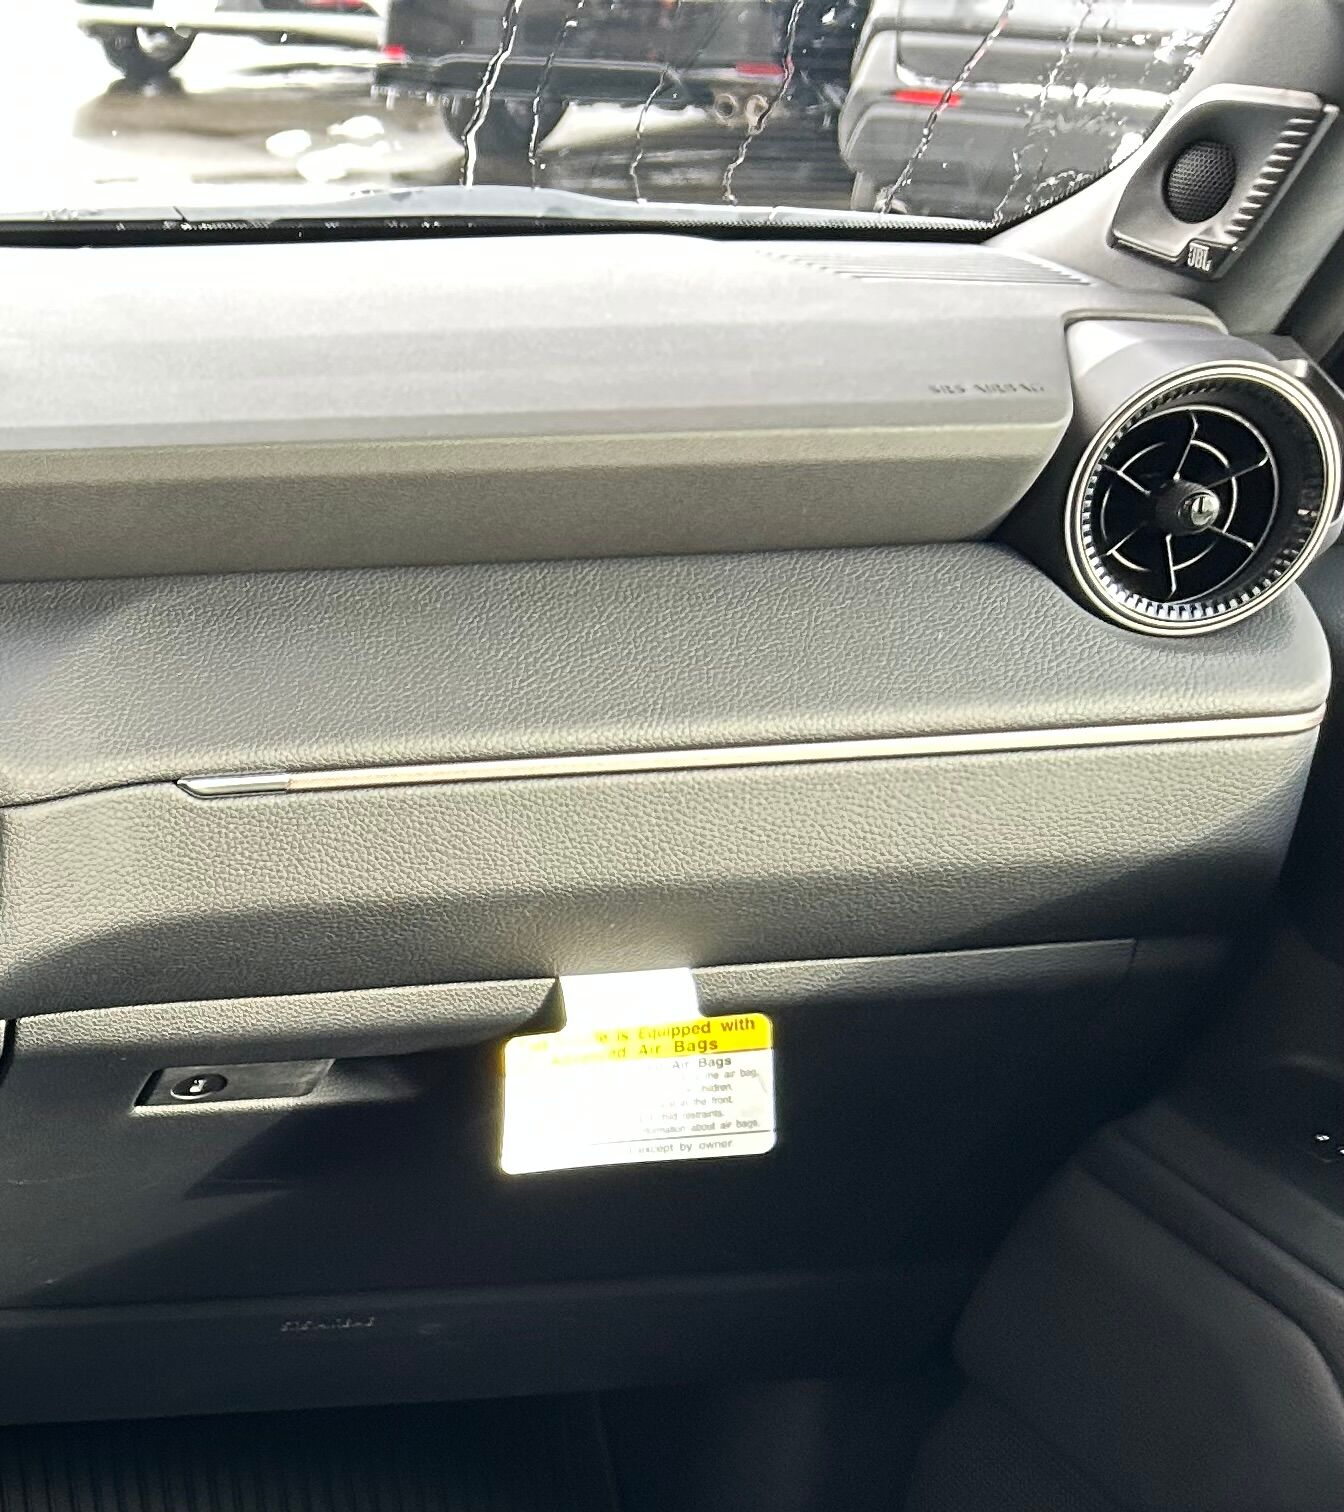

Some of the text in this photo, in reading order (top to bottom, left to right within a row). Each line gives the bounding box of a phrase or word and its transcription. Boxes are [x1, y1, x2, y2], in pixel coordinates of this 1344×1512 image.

[1188, 243, 1212, 271] JBL
[639, 1017, 755, 1040] Equipped with
[674, 1039, 718, 1053] Bags
[698, 1057, 732, 1069] Bags
[679, 1142, 693, 1152] by
